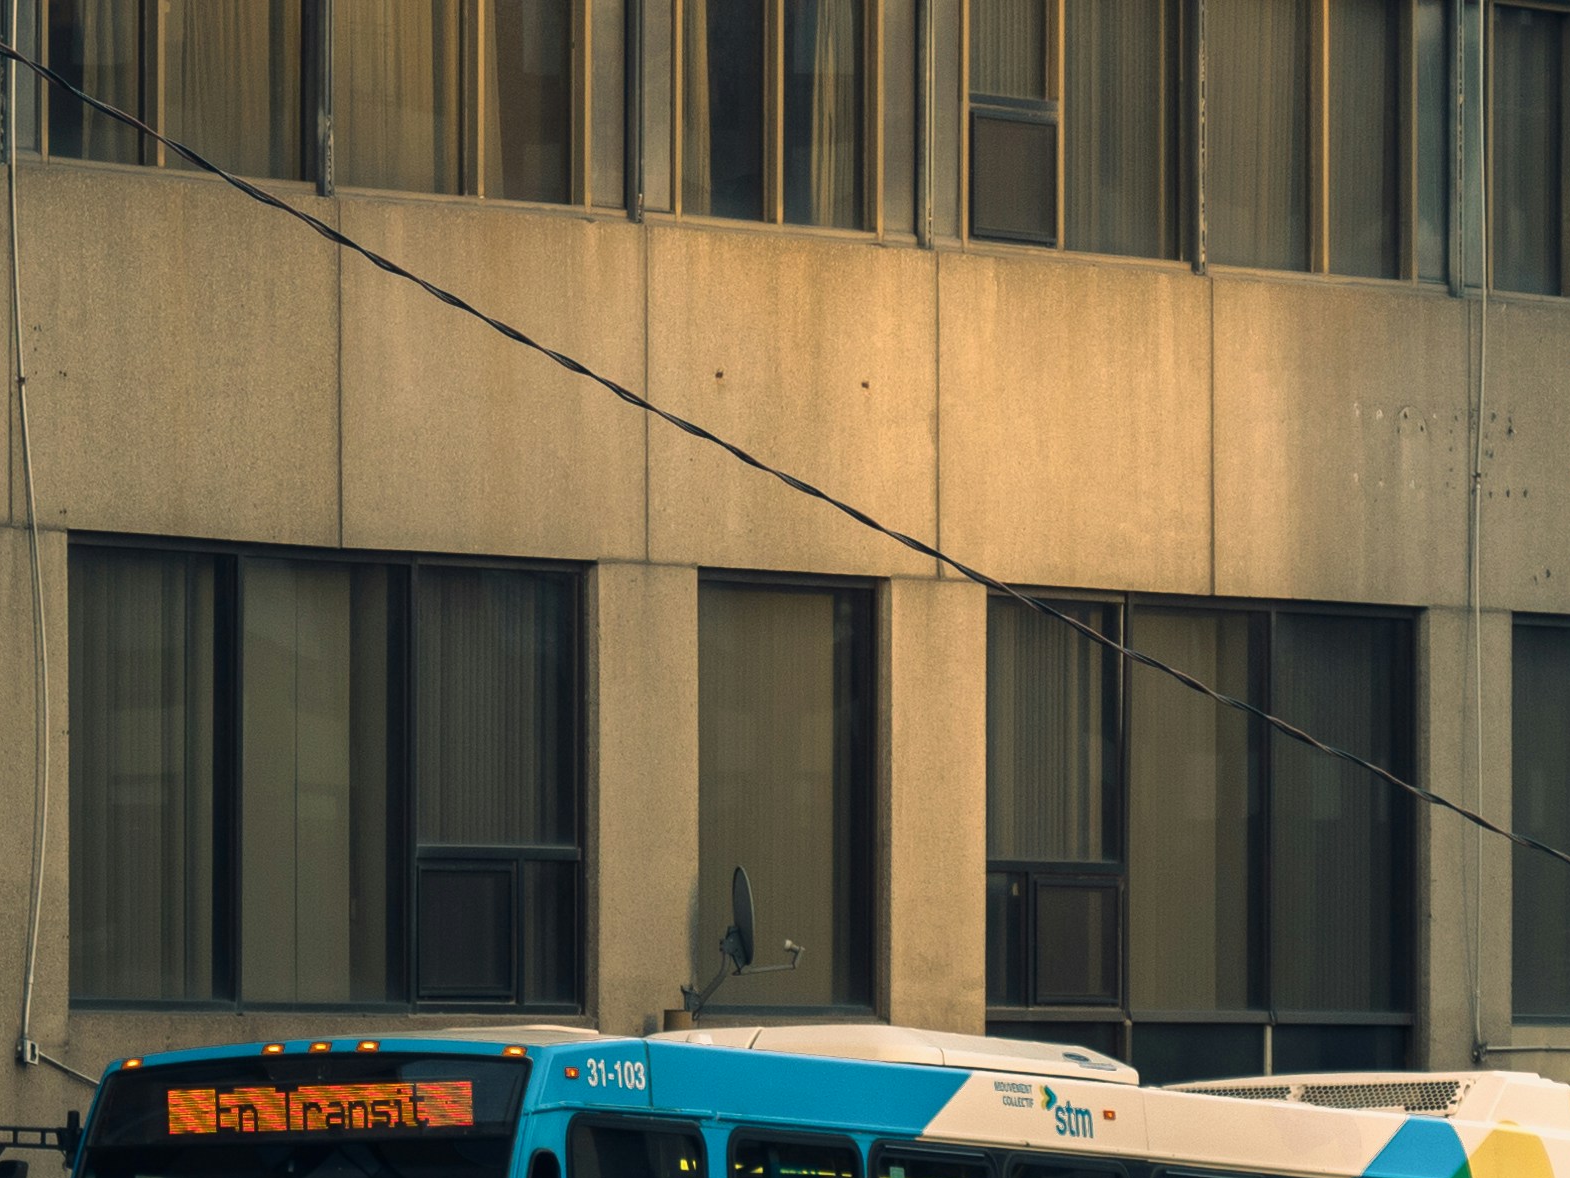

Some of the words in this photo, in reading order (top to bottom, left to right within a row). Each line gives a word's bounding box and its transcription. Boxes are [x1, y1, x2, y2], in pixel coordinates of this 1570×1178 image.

[587, 1058, 646, 1091] 31-103
[275, 1083, 430, 1132] Transit
[1002, 1096, 1035, 1109] COLLECTIF
[1055, 1101, 1094, 1139] stm
